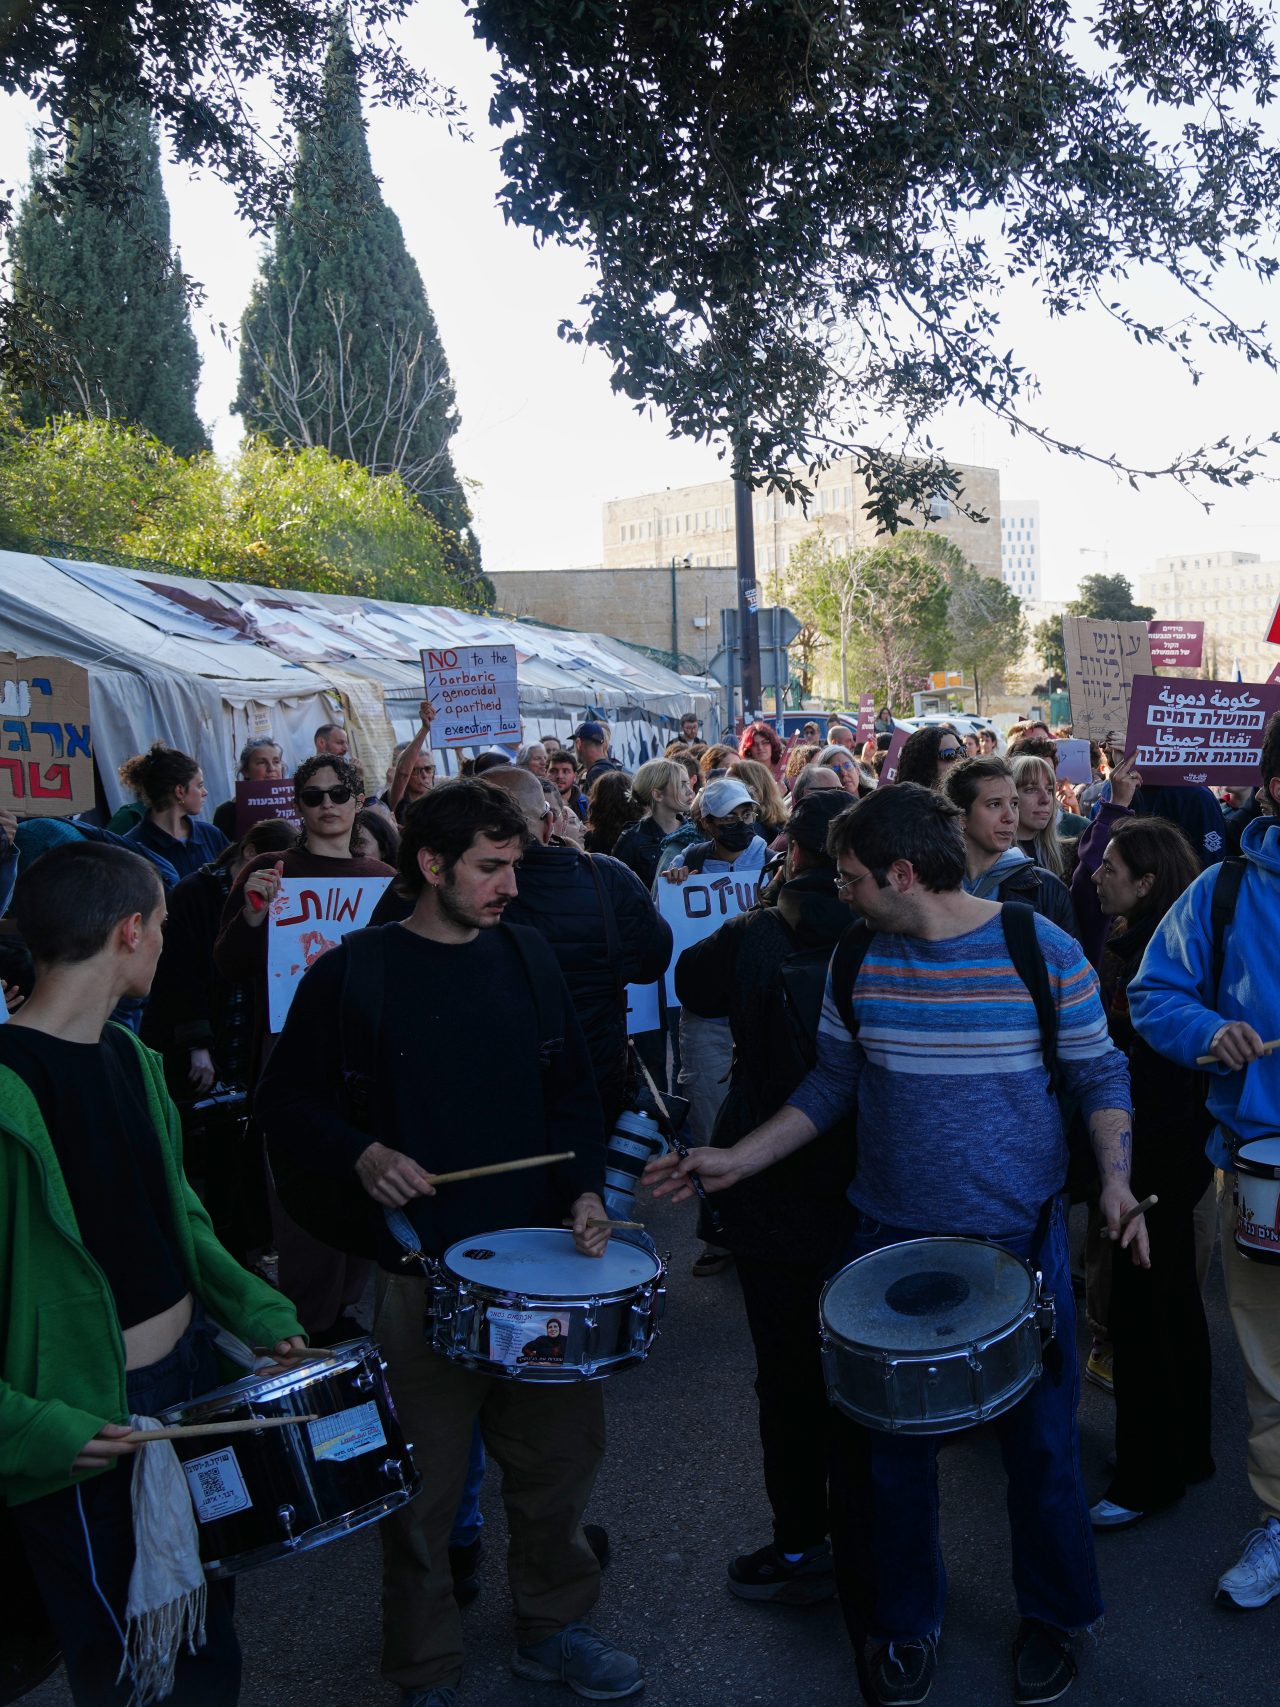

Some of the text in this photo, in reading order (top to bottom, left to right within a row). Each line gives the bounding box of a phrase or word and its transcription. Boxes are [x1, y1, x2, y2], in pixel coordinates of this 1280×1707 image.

[1186, 632, 1197, 640] של
[428, 650, 508, 670] NO to the
[439, 671, 496, 686] barbaric
[442, 684, 497, 703] genocidal
[1158, 686, 1260, 712] حكومة دموية
[445, 697, 502, 719] apartheid
[445, 715, 517, 736] execution law
[1152, 709, 1260, 726] ממשלת דמים
[0, 720, 92, 758] ארג
[1209, 731, 1252, 747] تقتلنا
[1139, 748, 1258, 763] הורגת את כולנו
[271, 785, 296, 795] ידיים
[248, 797, 286, 806] הגבעות
[683, 876, 759, 918] שיזם
